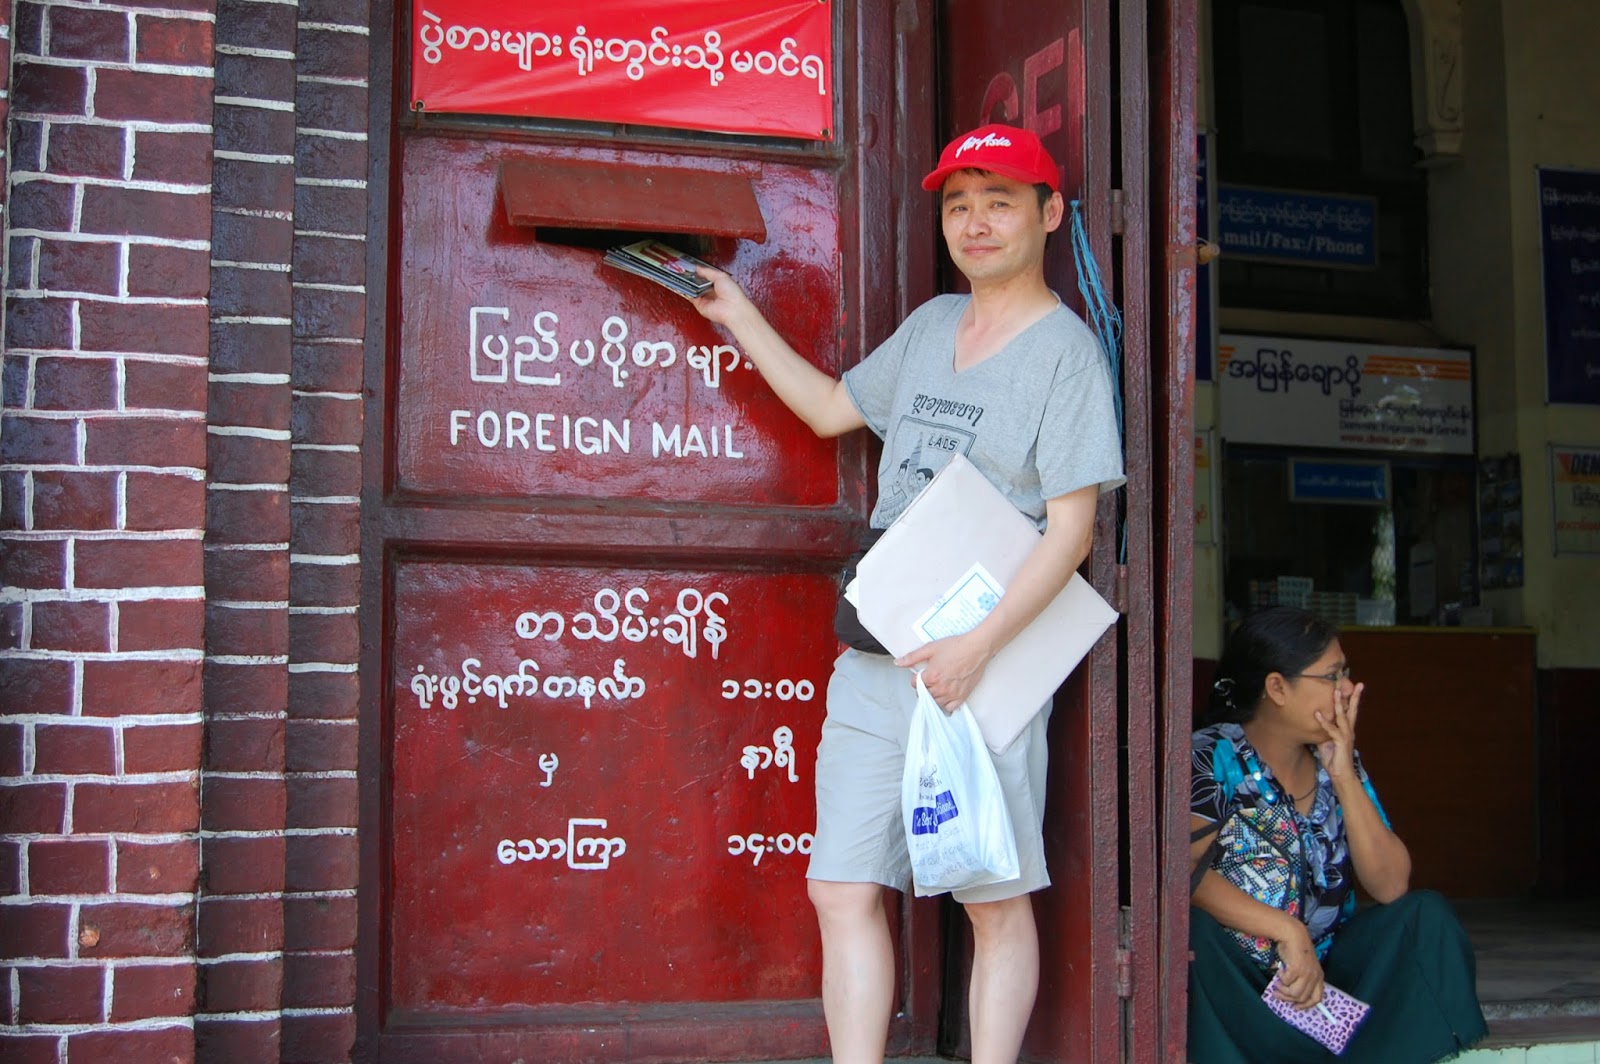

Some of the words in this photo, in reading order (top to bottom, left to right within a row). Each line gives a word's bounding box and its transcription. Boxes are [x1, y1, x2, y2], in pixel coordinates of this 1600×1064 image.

[420, 10, 562, 71] ပွဲစားများ
[569, 25, 725, 87] ရုံးတွင်းသို့
[1228, 348, 1362, 397] အမြန်ချောပို့
[450, 409, 631, 456] FOREIGN
[651, 421, 744, 459] MAIL
[928, 435, 958, 451] LAOS
[538, 752, 559, 787] မှ
[740, 725, 799, 783] နာရီ
[496, 818, 627, 870] သောကြာ
